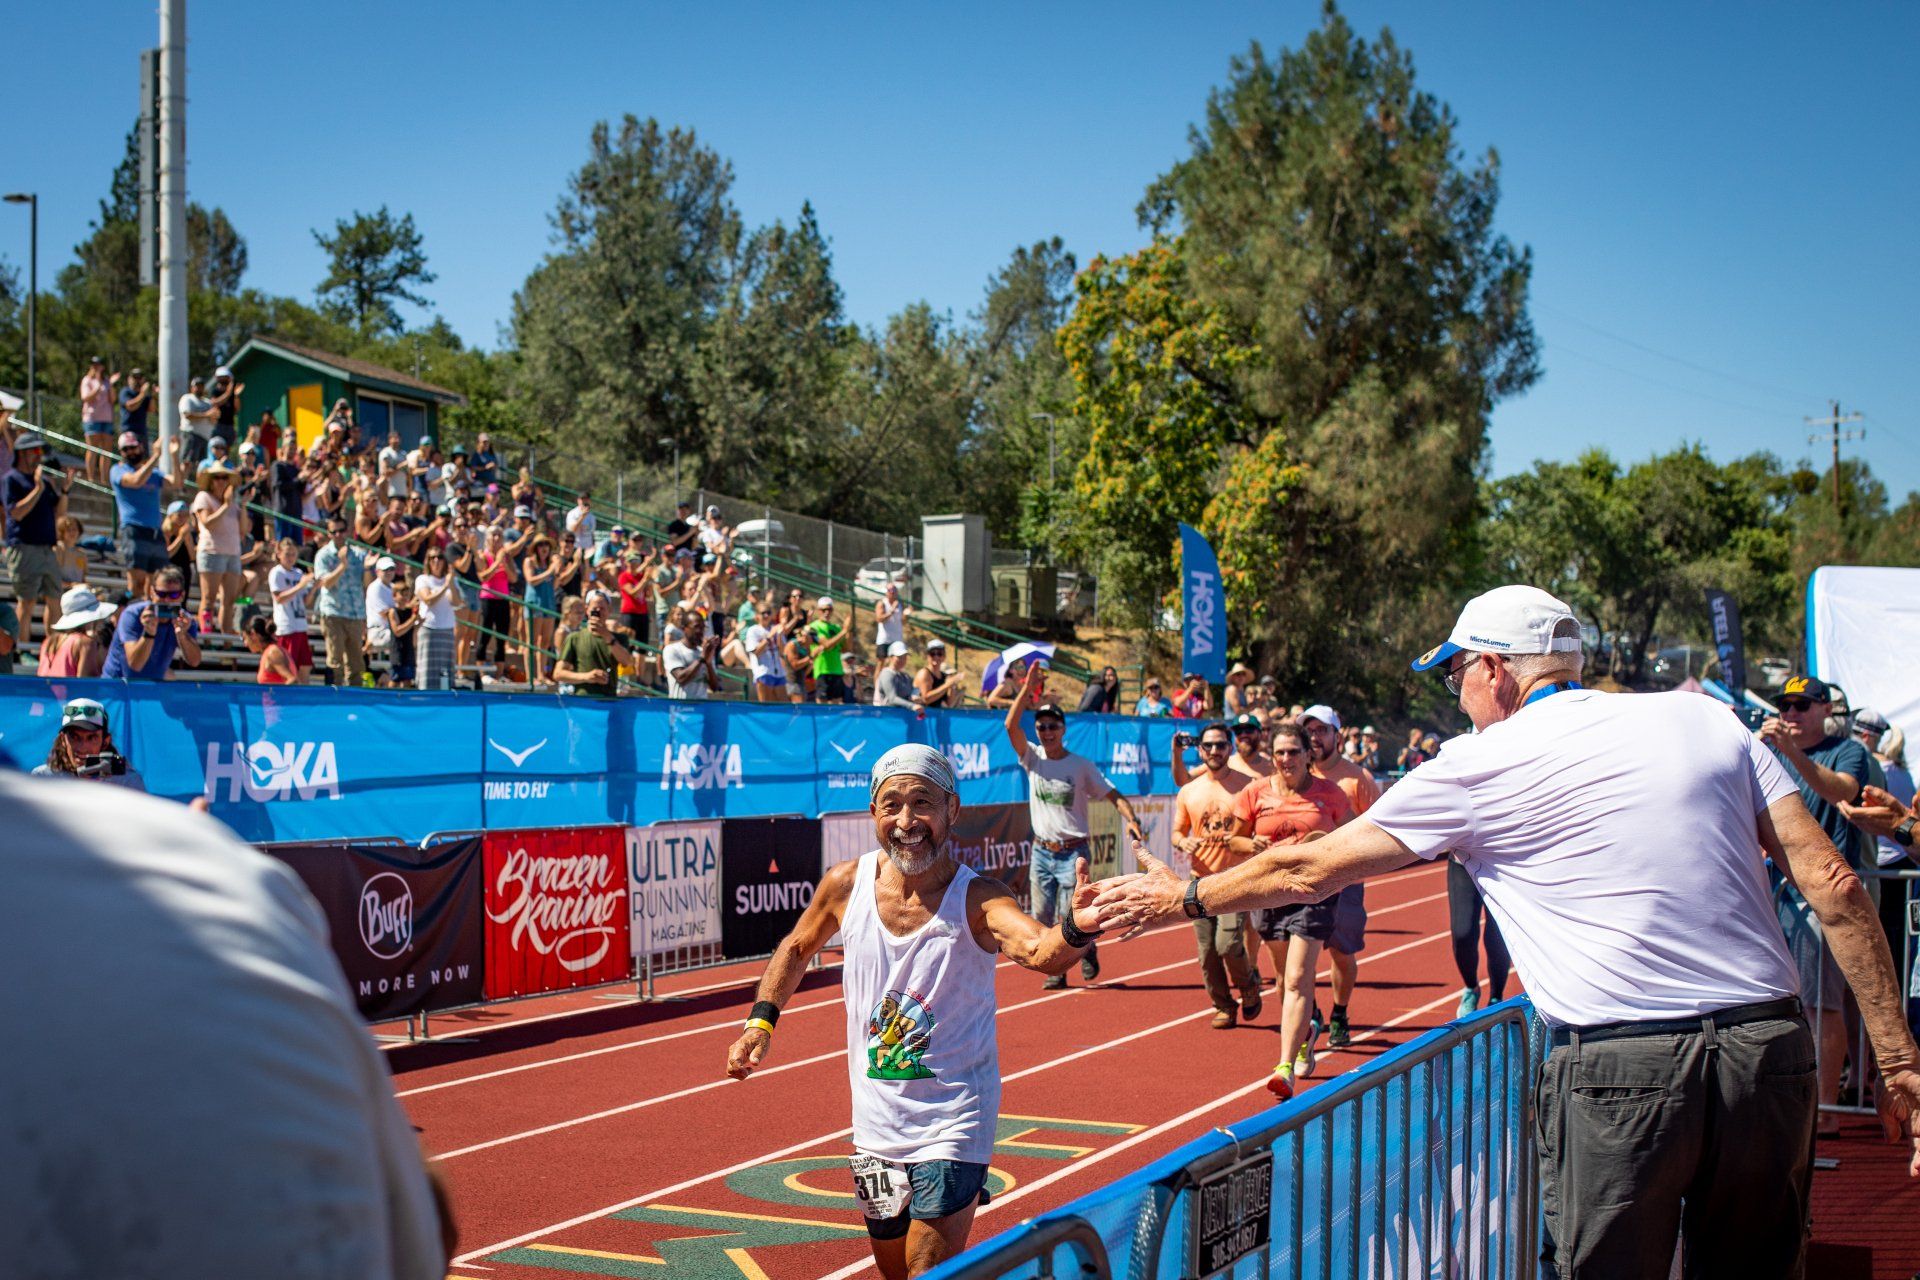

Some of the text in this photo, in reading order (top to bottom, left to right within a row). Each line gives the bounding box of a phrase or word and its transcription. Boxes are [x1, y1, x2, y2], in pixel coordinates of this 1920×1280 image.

[1191, 570, 1214, 657] HOKA
[1469, 635, 1511, 648] MicroLumen
[204, 741, 340, 803] HOKA
[660, 743, 744, 790] HOKA
[1110, 742, 1150, 775] HOKA
[483, 780, 550, 800] TIME TO FLY
[828, 774, 845, 788] TIME
[846, 774, 857, 788] TO
[857, 774, 869, 788] FLY
[632, 835, 716, 884] ULTRA
[486, 848, 614, 923] Brazen
[632, 882, 717, 921] RUNNING
[736, 881, 815, 914] SUUNTO
[511, 886, 626, 971] Racing
[651, 920, 706, 943] MAGAZINE
[360, 964, 470, 996] MORE NOW
[854, 1171, 893, 1201] 374
